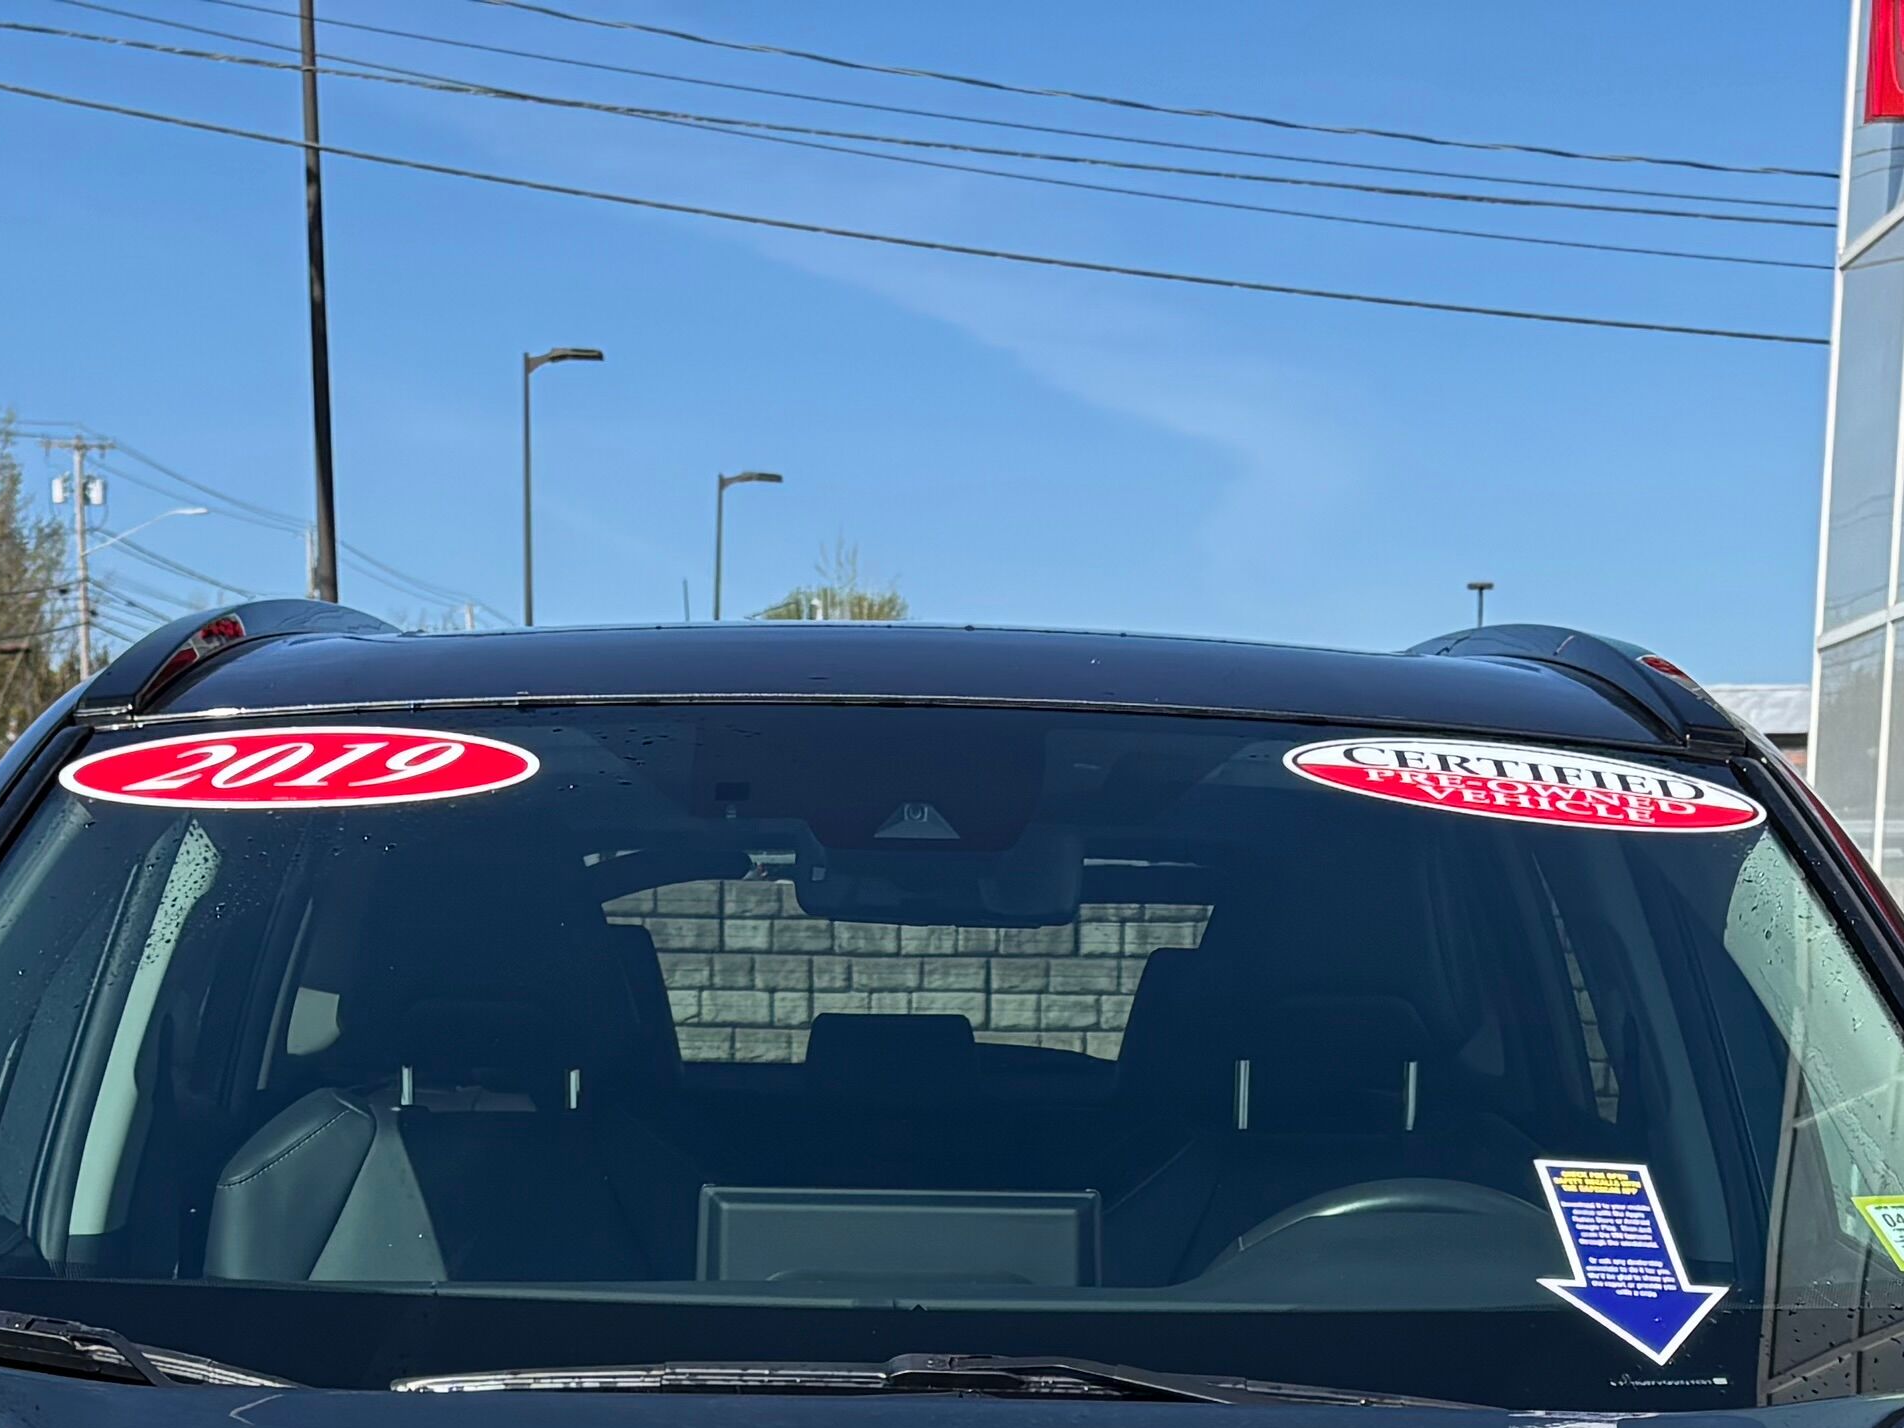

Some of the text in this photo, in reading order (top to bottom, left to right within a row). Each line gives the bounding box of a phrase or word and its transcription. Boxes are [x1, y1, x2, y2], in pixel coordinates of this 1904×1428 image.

[123, 741, 465, 791] 2019
[1342, 745, 1705, 800] CERTIFIED
[1366, 766, 1696, 815] PRE-OWNED
[1421, 785, 1655, 824] VEHICLE
